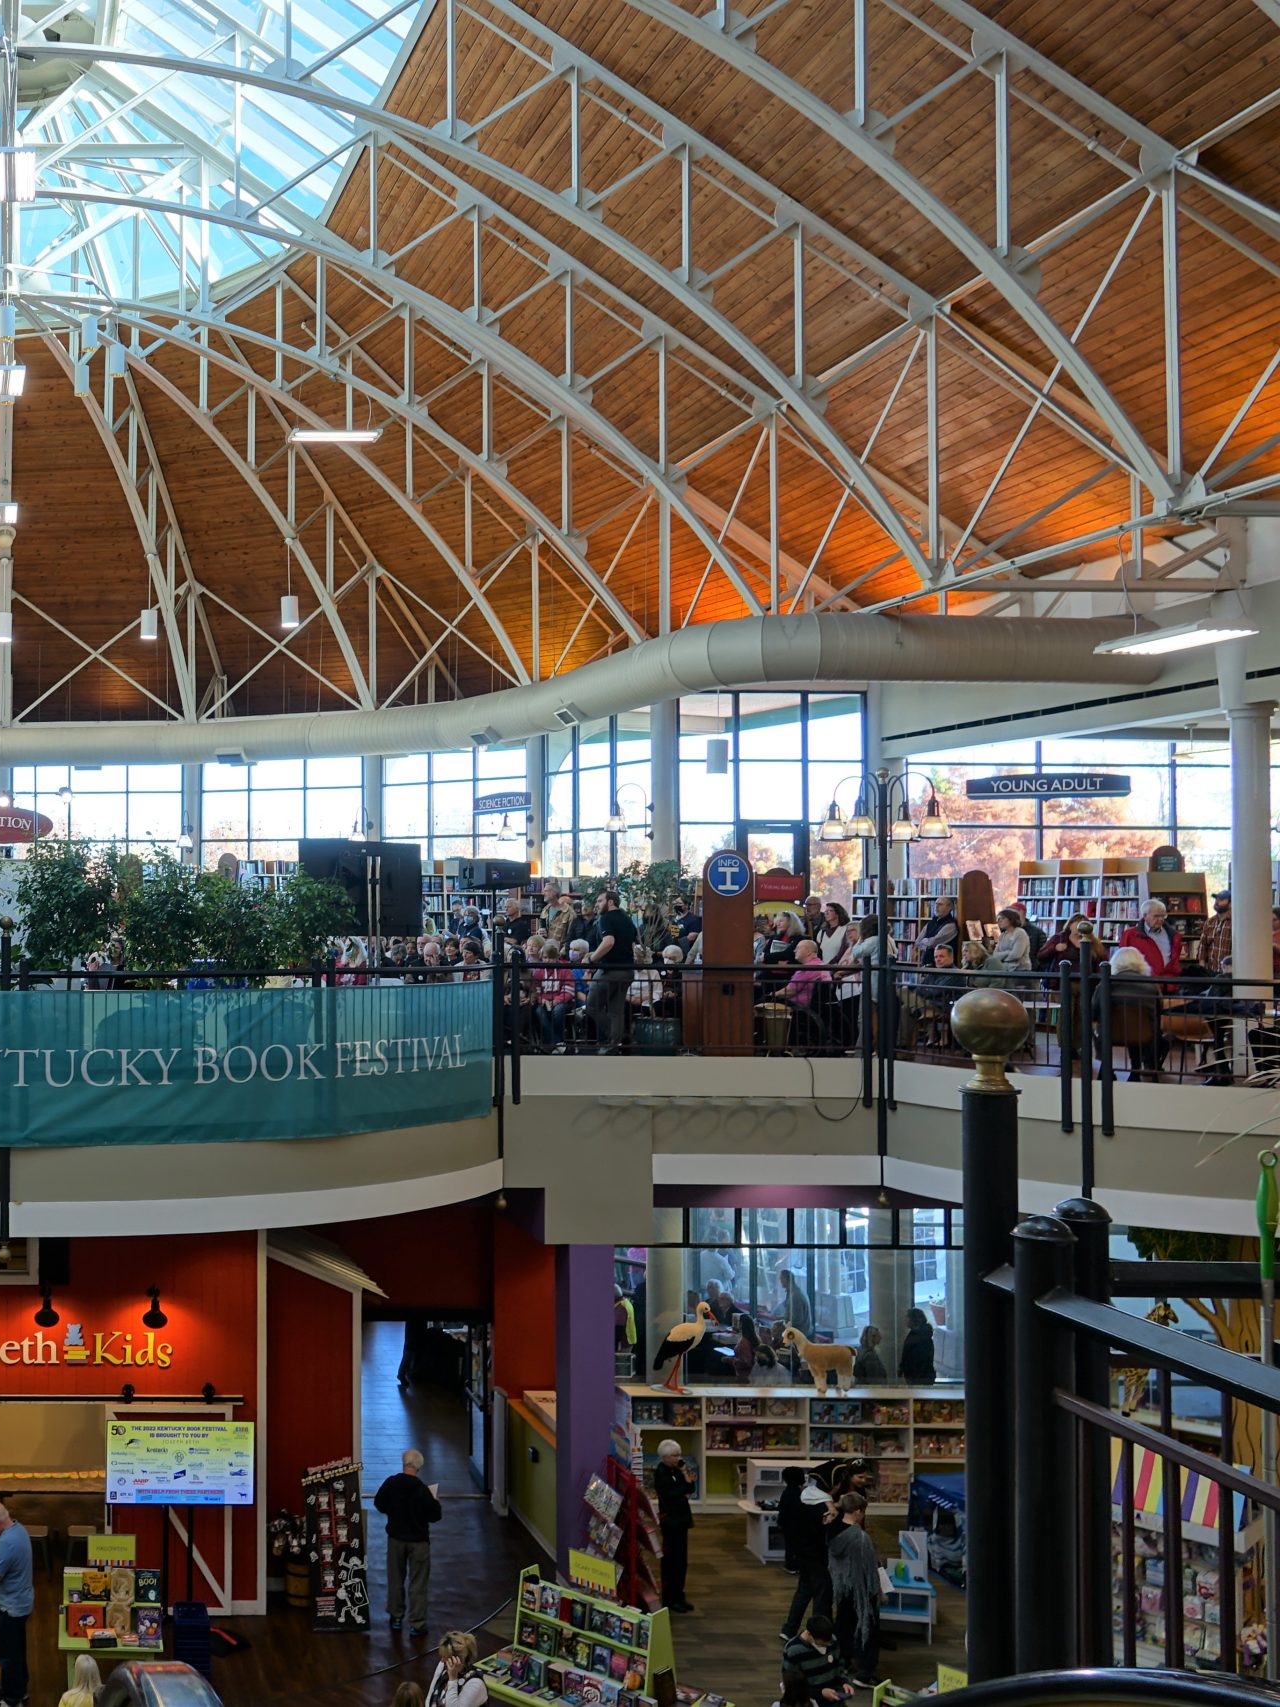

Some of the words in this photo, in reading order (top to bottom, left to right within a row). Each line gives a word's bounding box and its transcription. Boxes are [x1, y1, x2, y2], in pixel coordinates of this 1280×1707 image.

[991, 779, 1048, 792] YOUNG
[1050, 778, 1103, 791] ADULT
[479, 798, 502, 809] SCIENCE
[502, 796, 525, 807] FICTION
[717, 858, 740, 867] INFO
[194, 1043, 327, 1085] BOOK
[334, 1034, 467, 1078] FESTIVAL
[92, 1331, 173, 1369] Kids
